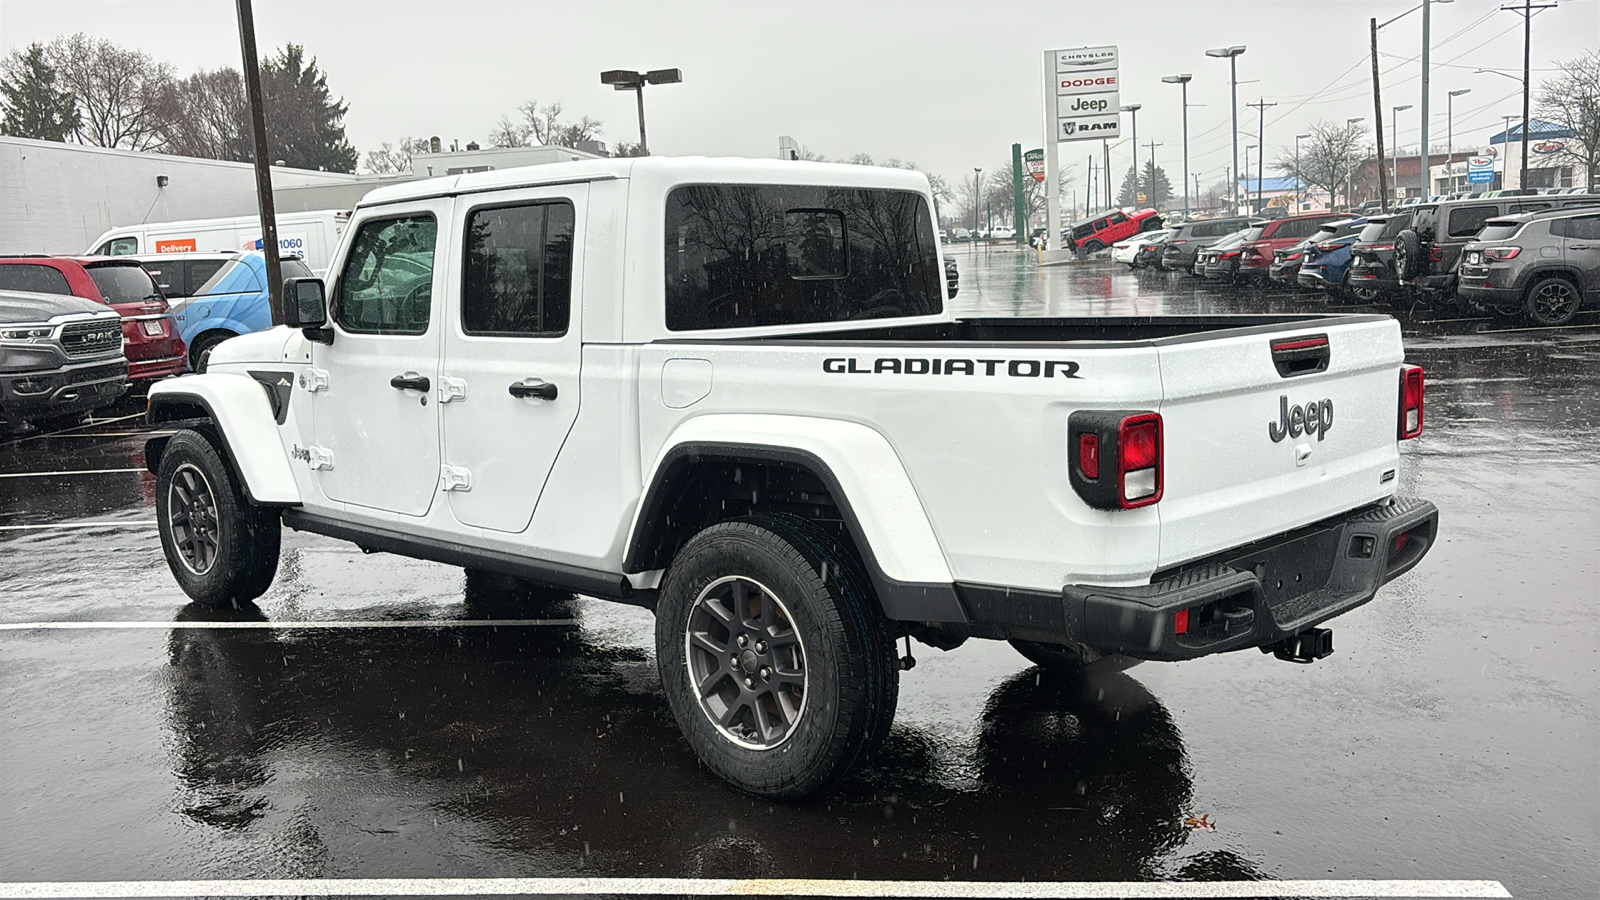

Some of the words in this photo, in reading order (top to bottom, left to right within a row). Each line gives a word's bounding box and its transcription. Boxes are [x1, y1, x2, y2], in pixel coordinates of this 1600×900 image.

[1061, 52, 1114, 60] CHRYSLER
[1061, 77, 1116, 88] DODGE
[1071, 98, 1108, 111] Jeep
[1078, 122, 1117, 131] RAM
[160, 244, 192, 252] Delivery
[279, 239, 302, 249] 1060
[823, 358, 1086, 379] GLADIATOR
[1269, 395, 1333, 443] Jeep
[291, 443, 311, 464] Jeep
